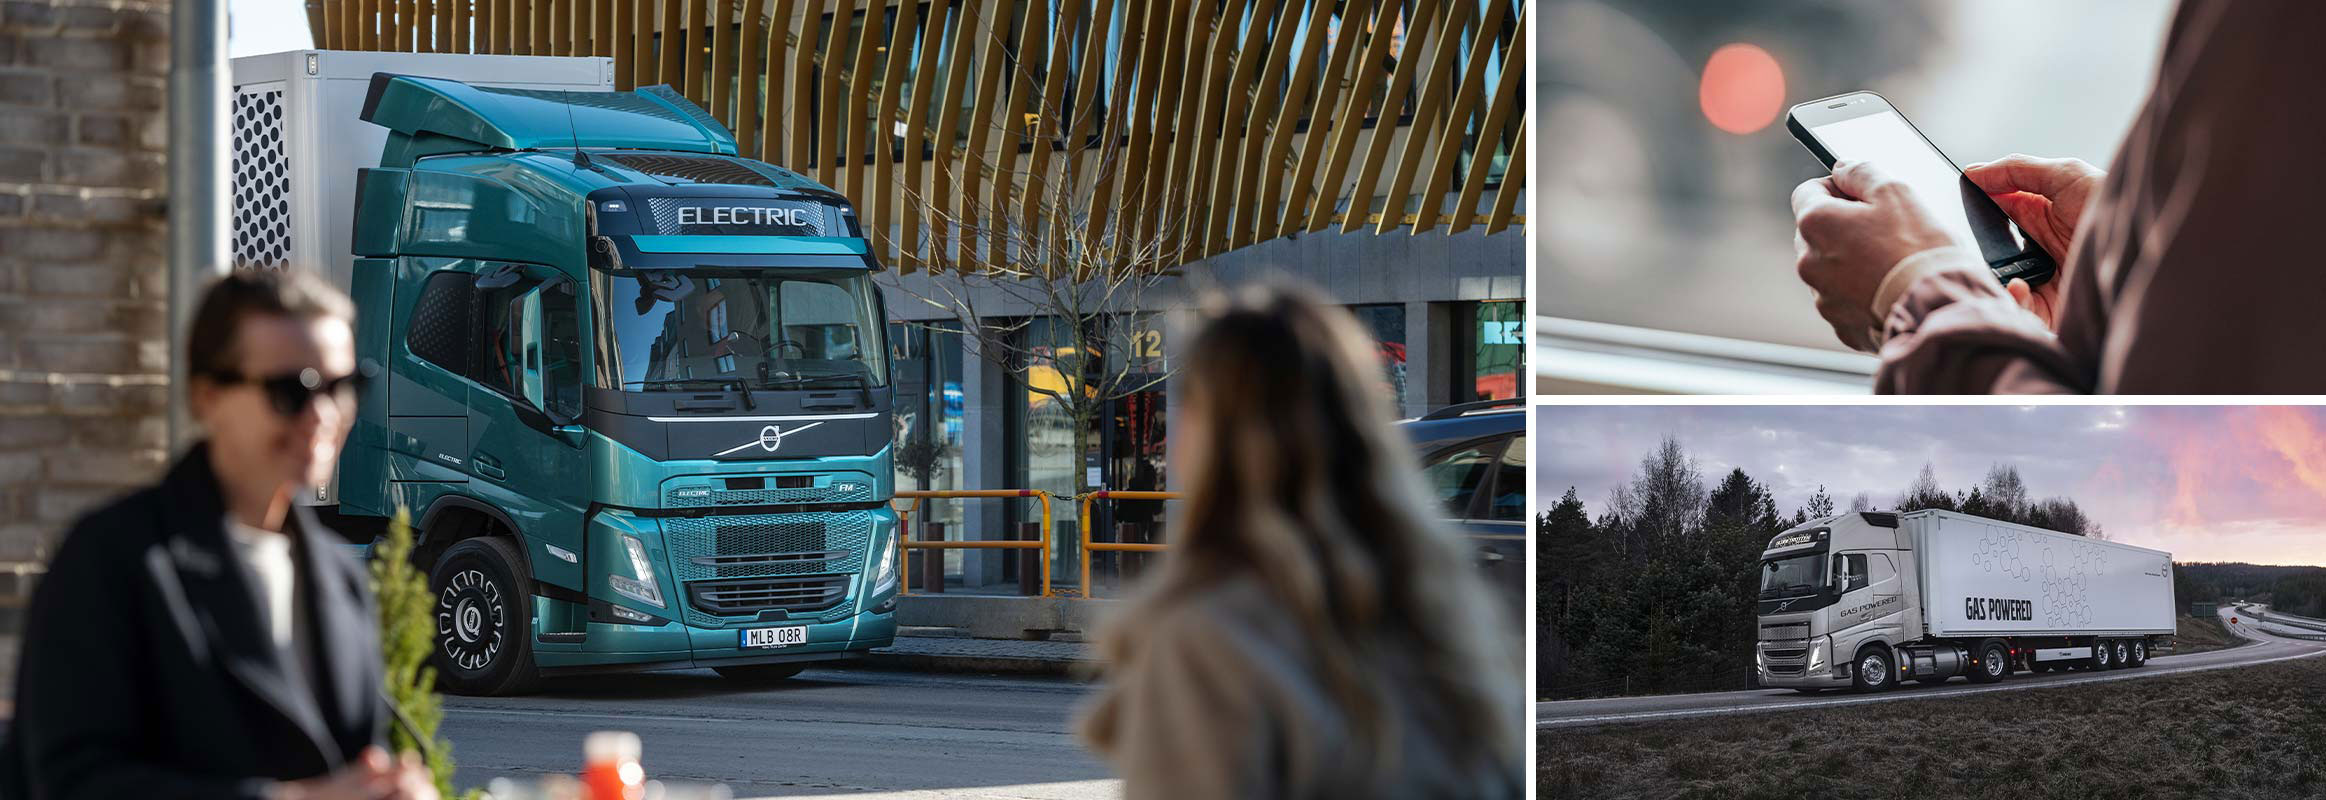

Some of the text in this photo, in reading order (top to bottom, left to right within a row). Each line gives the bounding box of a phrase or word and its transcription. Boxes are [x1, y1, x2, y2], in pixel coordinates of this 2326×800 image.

[678, 207, 806, 226] ELECTRIC
[1132, 330, 1161, 357] 12
[1840, 596, 1897, 617] GAS POWERED
[1965, 597, 2033, 621] GAS POWERED
[751, 628, 801, 645] MLB 08R
